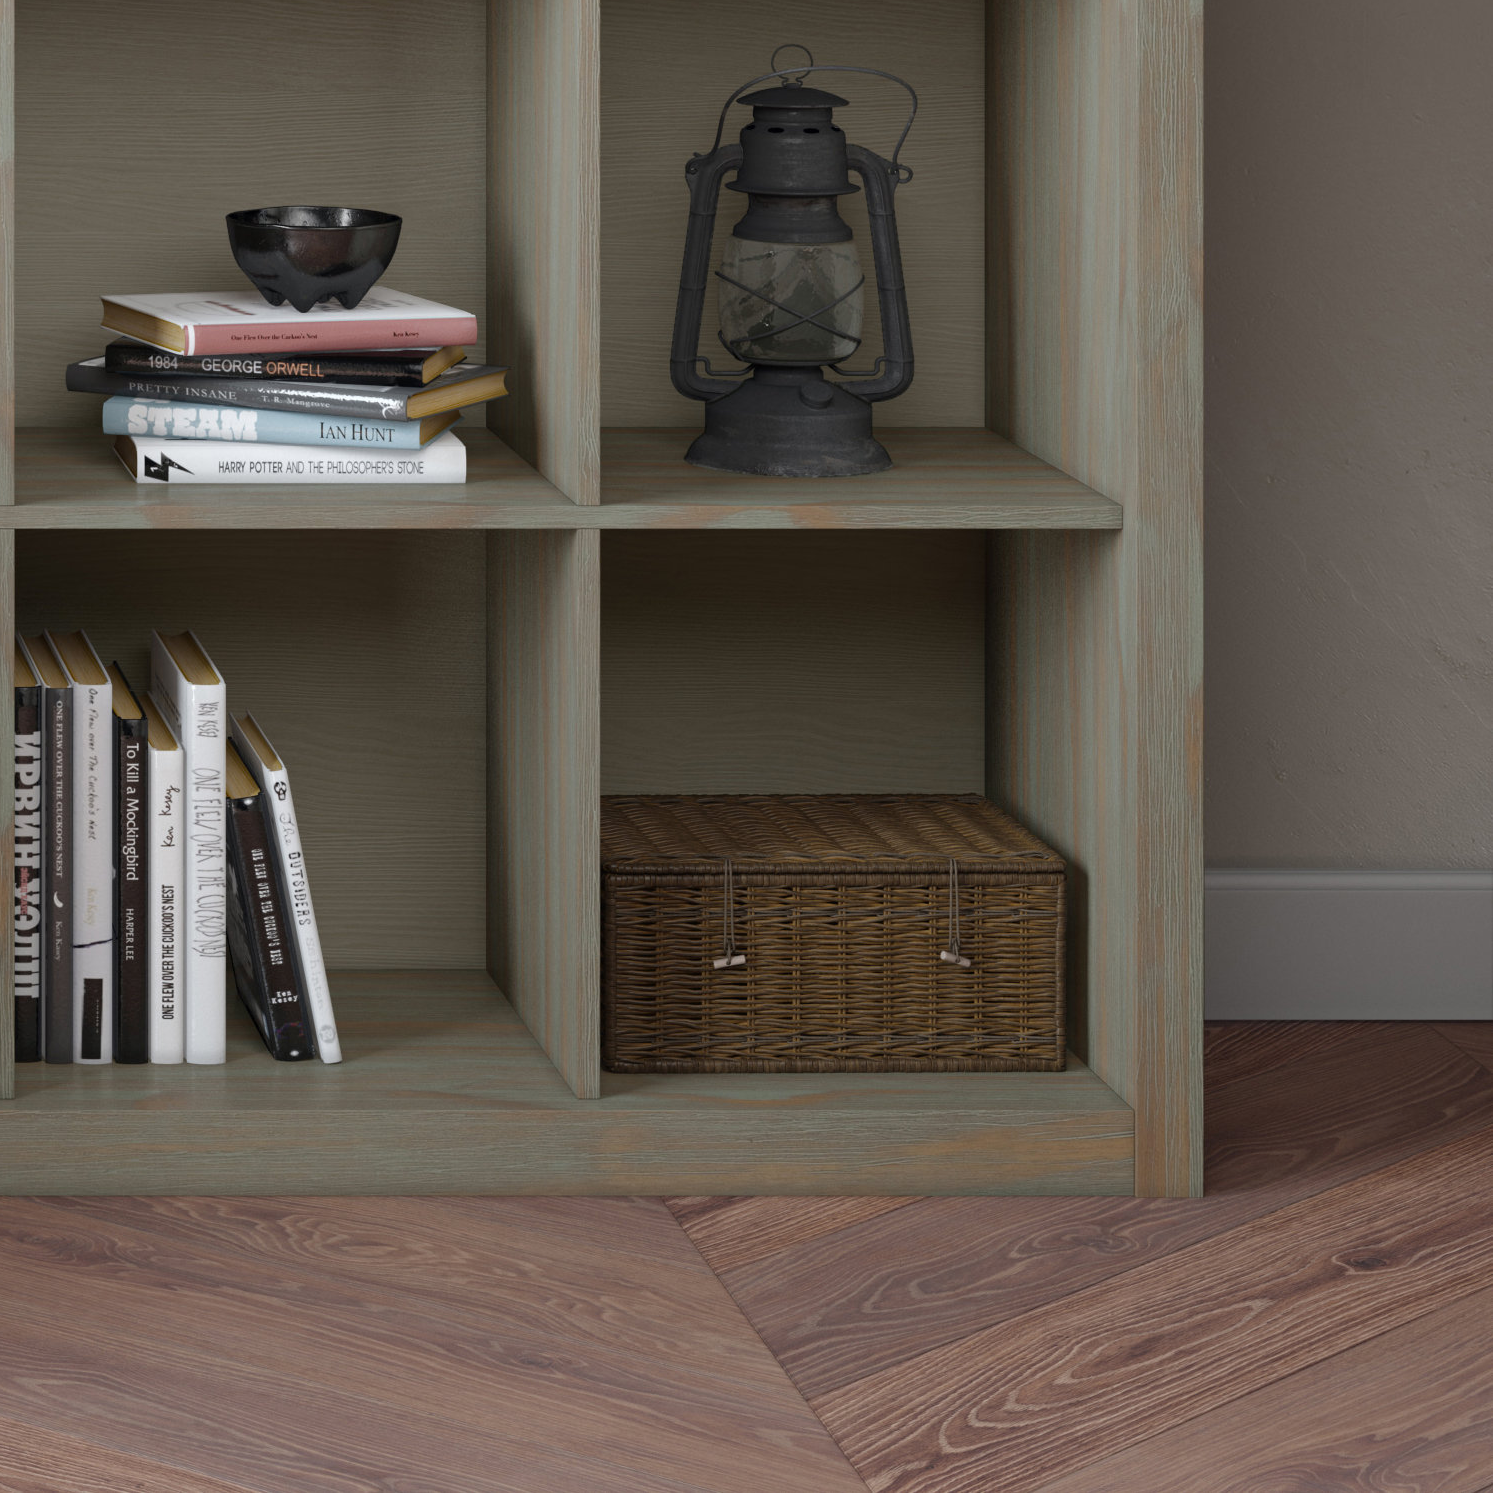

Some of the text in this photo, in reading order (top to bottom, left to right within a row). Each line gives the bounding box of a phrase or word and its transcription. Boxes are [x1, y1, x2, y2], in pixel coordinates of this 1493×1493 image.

[148, 355, 325, 378] 1984 GEORGE ORWELL
[129, 381, 330, 408] PRETTY INSANE Mangrove
[127, 404, 258, 441] STEAM
[218, 460, 424, 475] HARRY POTTER AND THE PHILOSOPHER'S STONE
[88, 688, 99, 705] One
[88, 733, 97, 750] over
[126, 742, 139, 758] To
[126, 762, 139, 783] Kill
[191, 767, 221, 793] ONE
[15, 730, 42, 869] ИРВИН
[55, 700, 64, 936] ONE FLEW OVER THE CUCKOO'S NEST Ken
[158, 785, 180, 848] Ken Kesey
[87, 820, 98, 841] Nest
[122, 798, 140, 881] Mockingbird
[190, 833, 224, 863] OVER
[288, 851, 311, 926] OUTSIDERS
[125, 908, 134, 943] HARPER
[125, 945, 134, 961] LEE
[161, 884, 175, 1020] ONE FLEW OVER THE CUCKOO'S NEST
